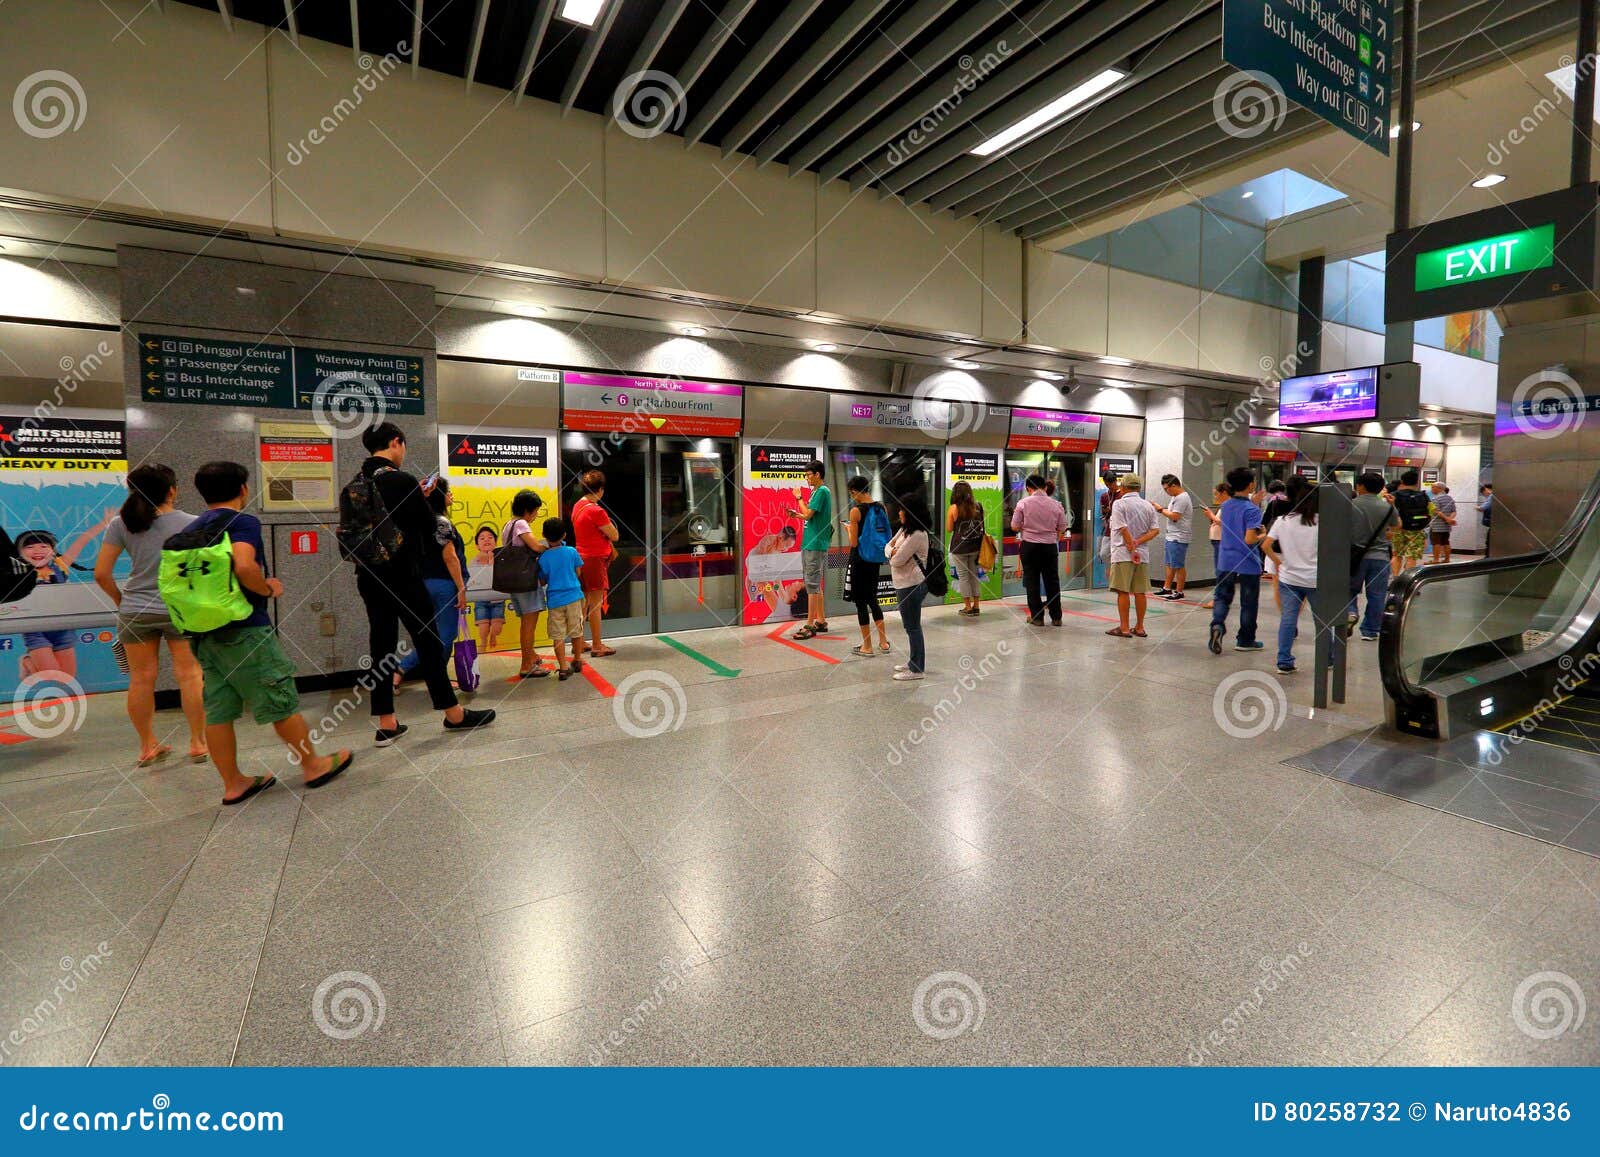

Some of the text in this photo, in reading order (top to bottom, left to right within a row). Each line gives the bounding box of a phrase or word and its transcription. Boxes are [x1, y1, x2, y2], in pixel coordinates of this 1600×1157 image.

[1311, 0, 1356, 51] Platform
[1264, 3, 1355, 86] Bus Interchange
[1296, 63, 1320, 102] Way
[1322, 86, 1340, 111] out
[1445, 239, 1519, 281] EXIT
[195, 344, 243, 358] Punggol
[246, 348, 286, 360] Central
[179, 357, 281, 374] Passenger service
[315, 353, 366, 367] Waterway
[368, 358, 395, 368] Point
[180, 373, 275, 389] Bus Interchange
[315, 368, 357, 381] Punggol
[360, 371, 395, 382] Central
[519, 370, 551, 381] Platform
[349, 383, 382, 395] Toilets
[634, 380, 653, 388] North
[181, 388, 203, 399] LRT
[219, 391, 237, 401] 2nd
[238, 391, 268, 403] Storey)
[327, 397, 346, 407] LRT
[632, 397, 643, 408] to
[646, 397, 713, 411] HarbourFront
[877, 402, 910, 414] Pugol
[1533, 401, 1590, 412] Platform
[852, 408, 872, 416] NE17
[17, 428, 122, 439] MITSUBISHI
[55, 437, 121, 445] INDUSTRIES
[40, 447, 122, 455] CONDITIONERS
[477, 444, 540, 452] MITSUBISHI
[0, 460, 112, 470] HEAVY DUTY
[503, 468, 534, 476] DUTY
